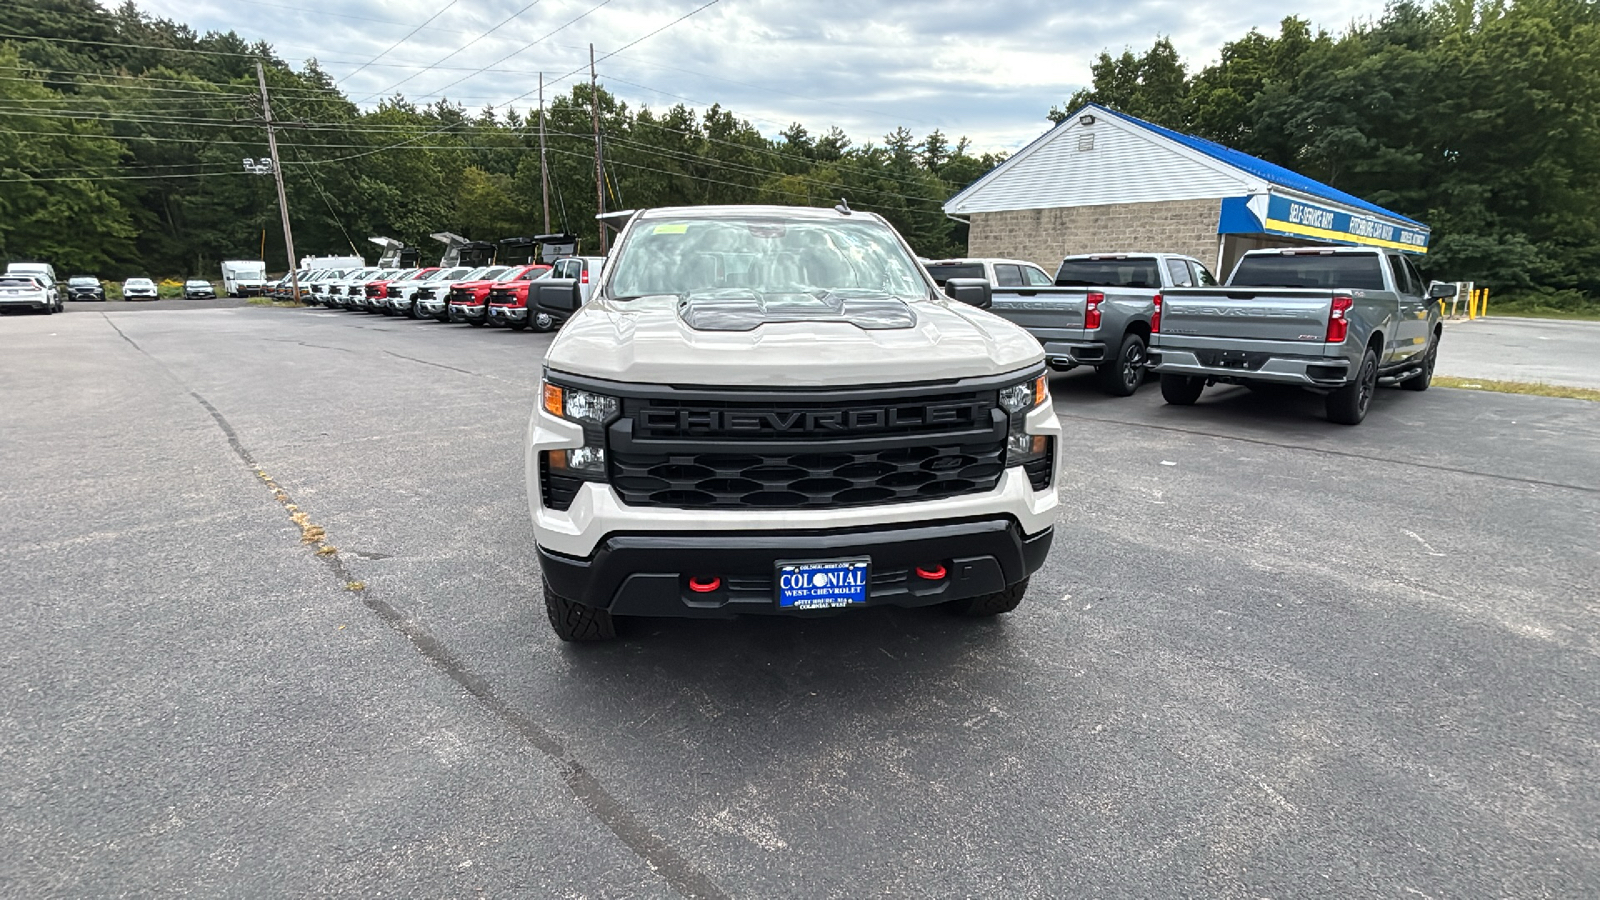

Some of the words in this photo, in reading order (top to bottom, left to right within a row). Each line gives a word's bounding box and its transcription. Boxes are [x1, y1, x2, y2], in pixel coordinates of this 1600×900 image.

[1290, 203, 1322, 226] SELF-SERVICE
[1170, 306, 1316, 318] CHEVROLET
[640, 402, 990, 431] CHEVROLET
[780, 571, 865, 589] COLONIAL
